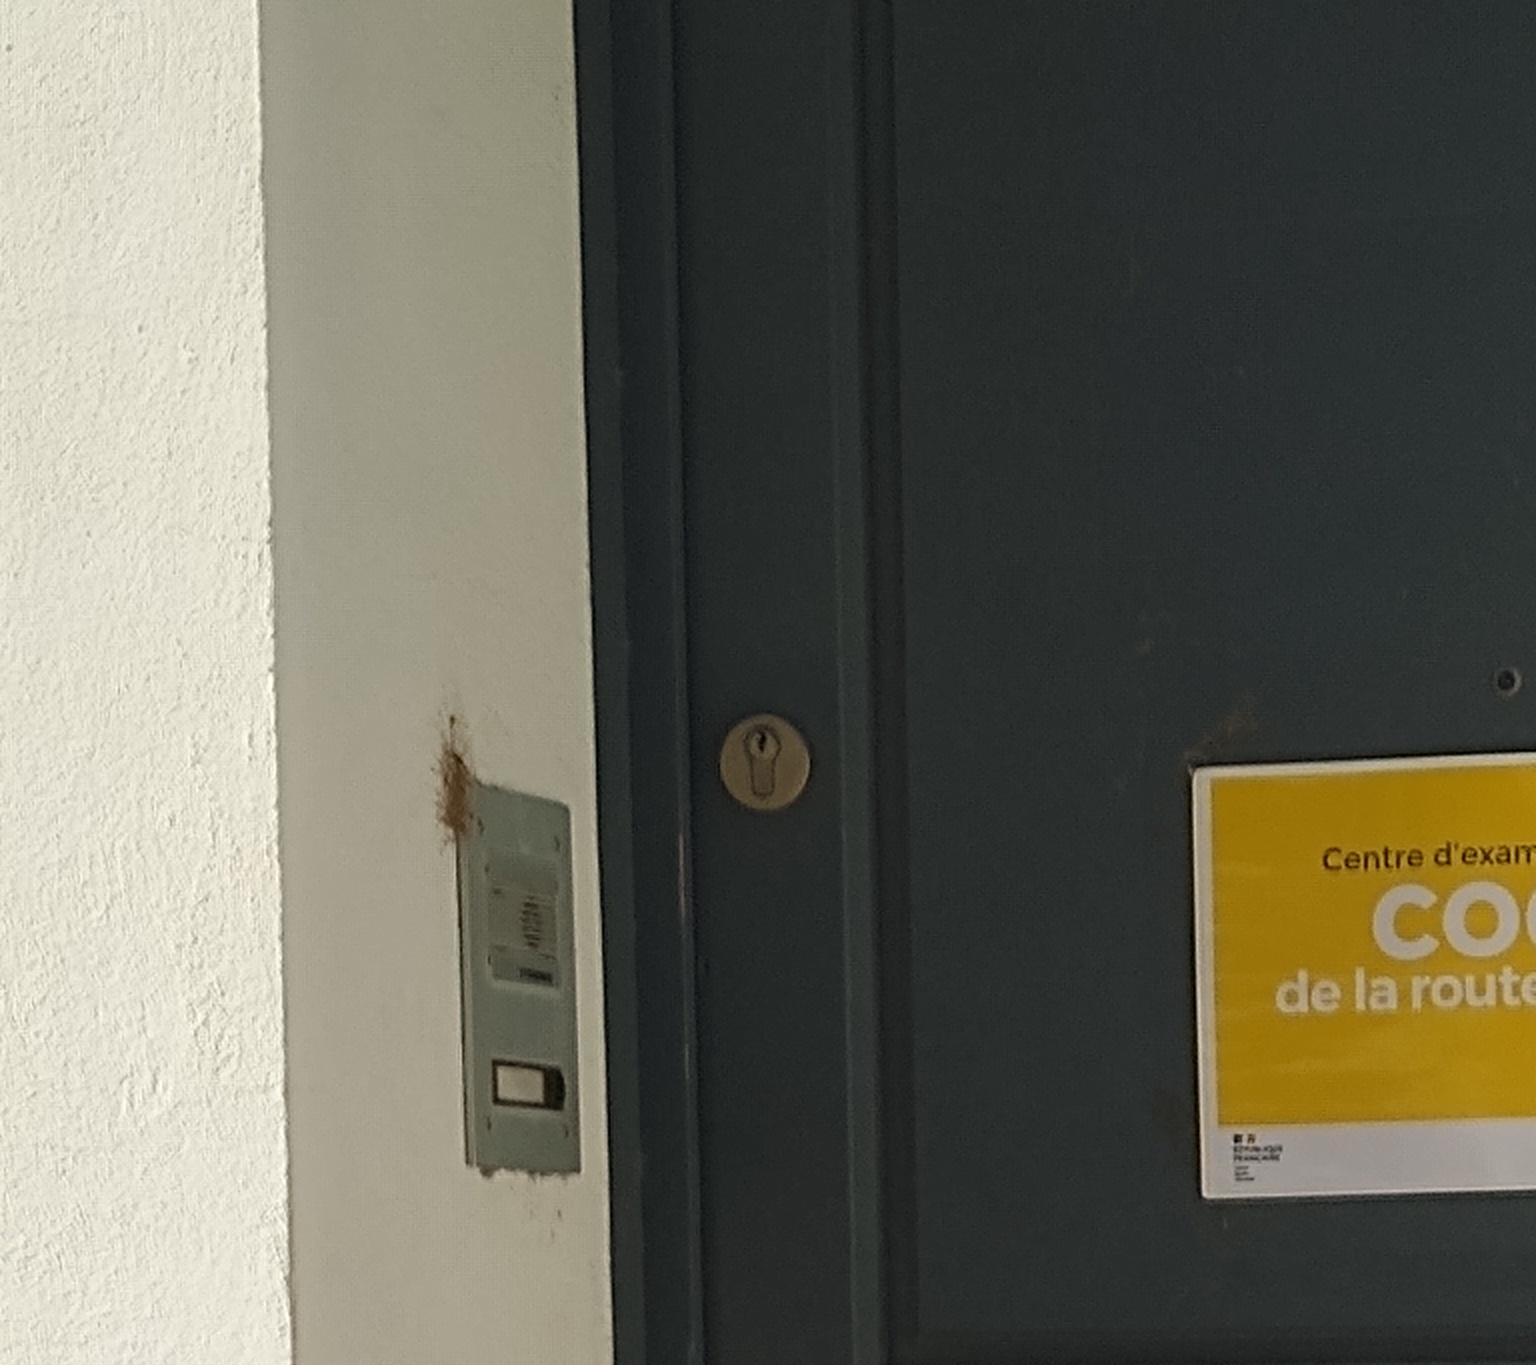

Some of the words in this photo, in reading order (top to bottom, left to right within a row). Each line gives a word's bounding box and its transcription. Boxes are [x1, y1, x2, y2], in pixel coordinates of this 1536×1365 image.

[1321, 846, 1424, 872] Centre
[1275, 968, 1341, 1015] de
[1354, 966, 1398, 1011] la
